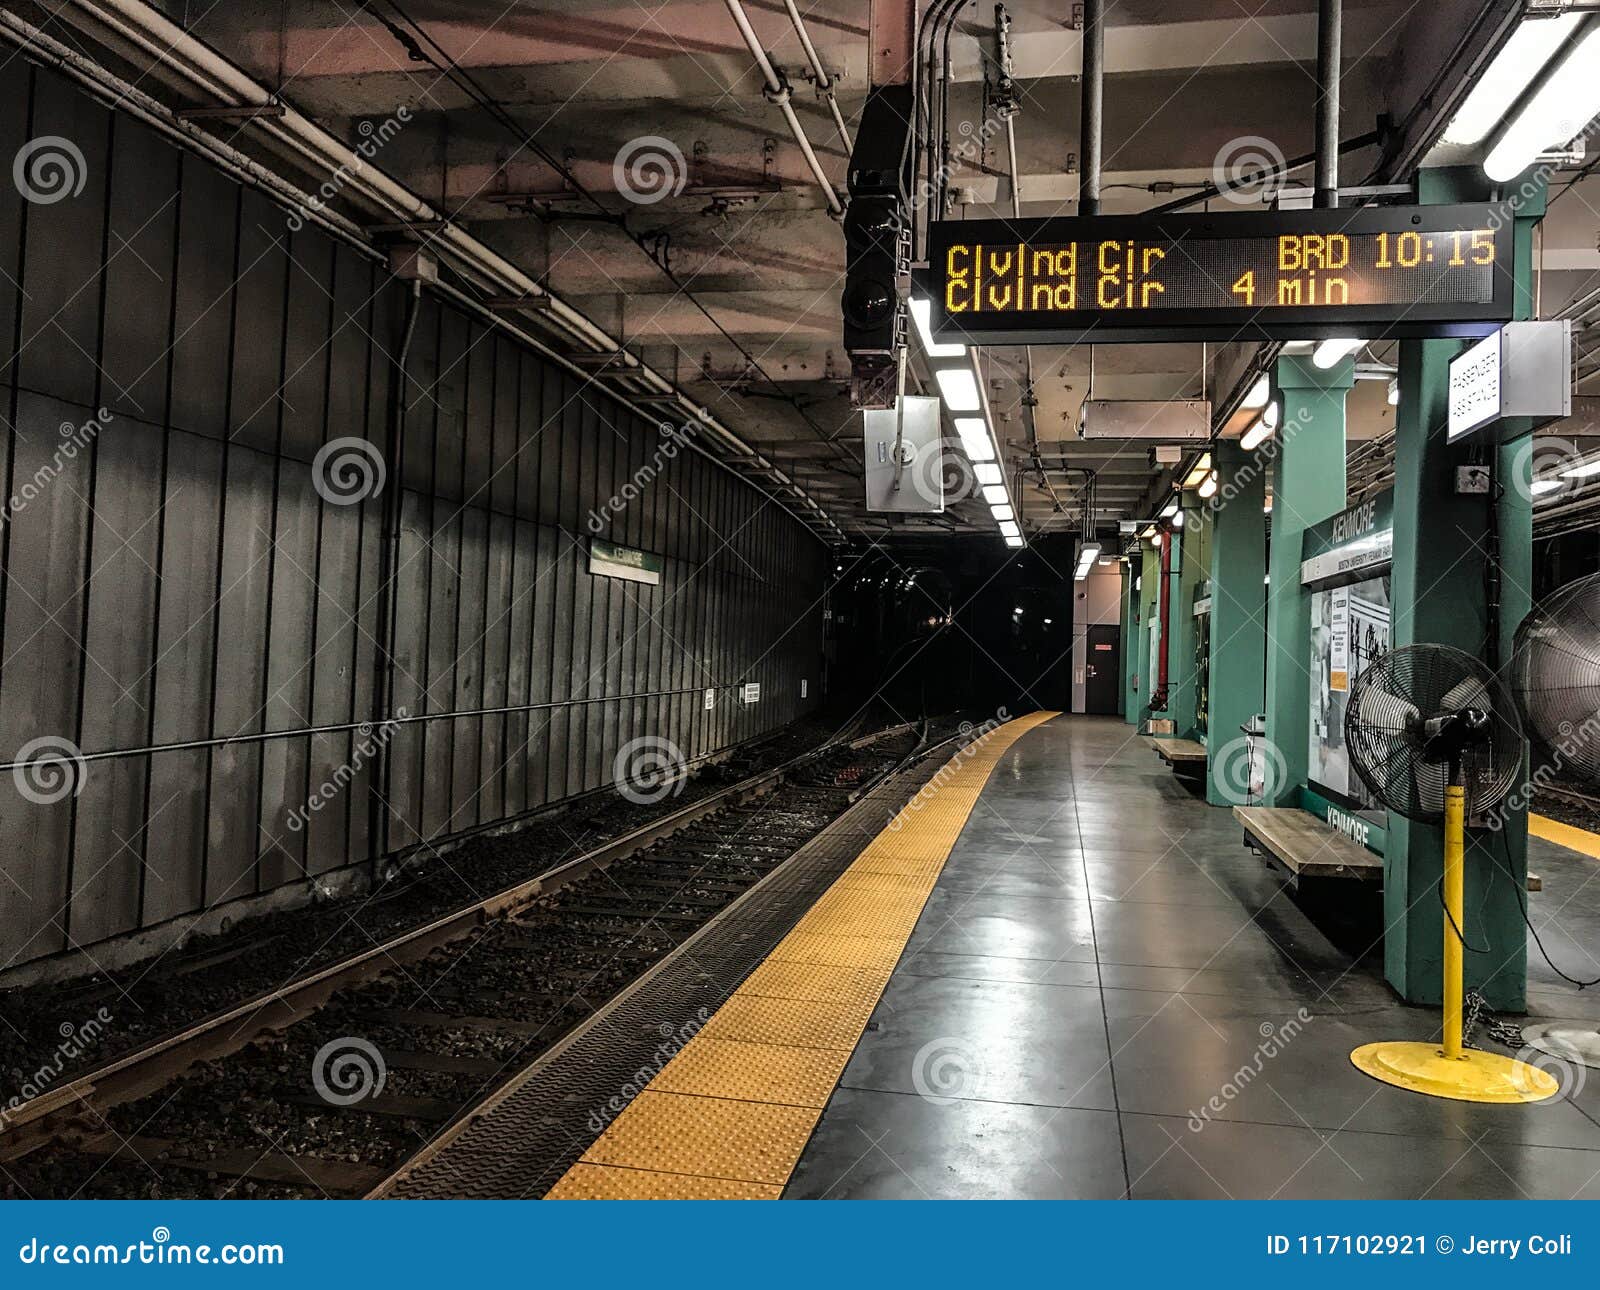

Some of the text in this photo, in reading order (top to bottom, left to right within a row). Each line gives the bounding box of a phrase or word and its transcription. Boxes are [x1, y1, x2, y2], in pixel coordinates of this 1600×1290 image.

[946, 229, 1496, 279] Clvlnd Cir BRD 10:15
[945, 270, 1349, 313] Clvlnd Cir 4 min
[1332, 500, 1376, 545] KENMORE
[1327, 805, 1369, 848] KENMORE
